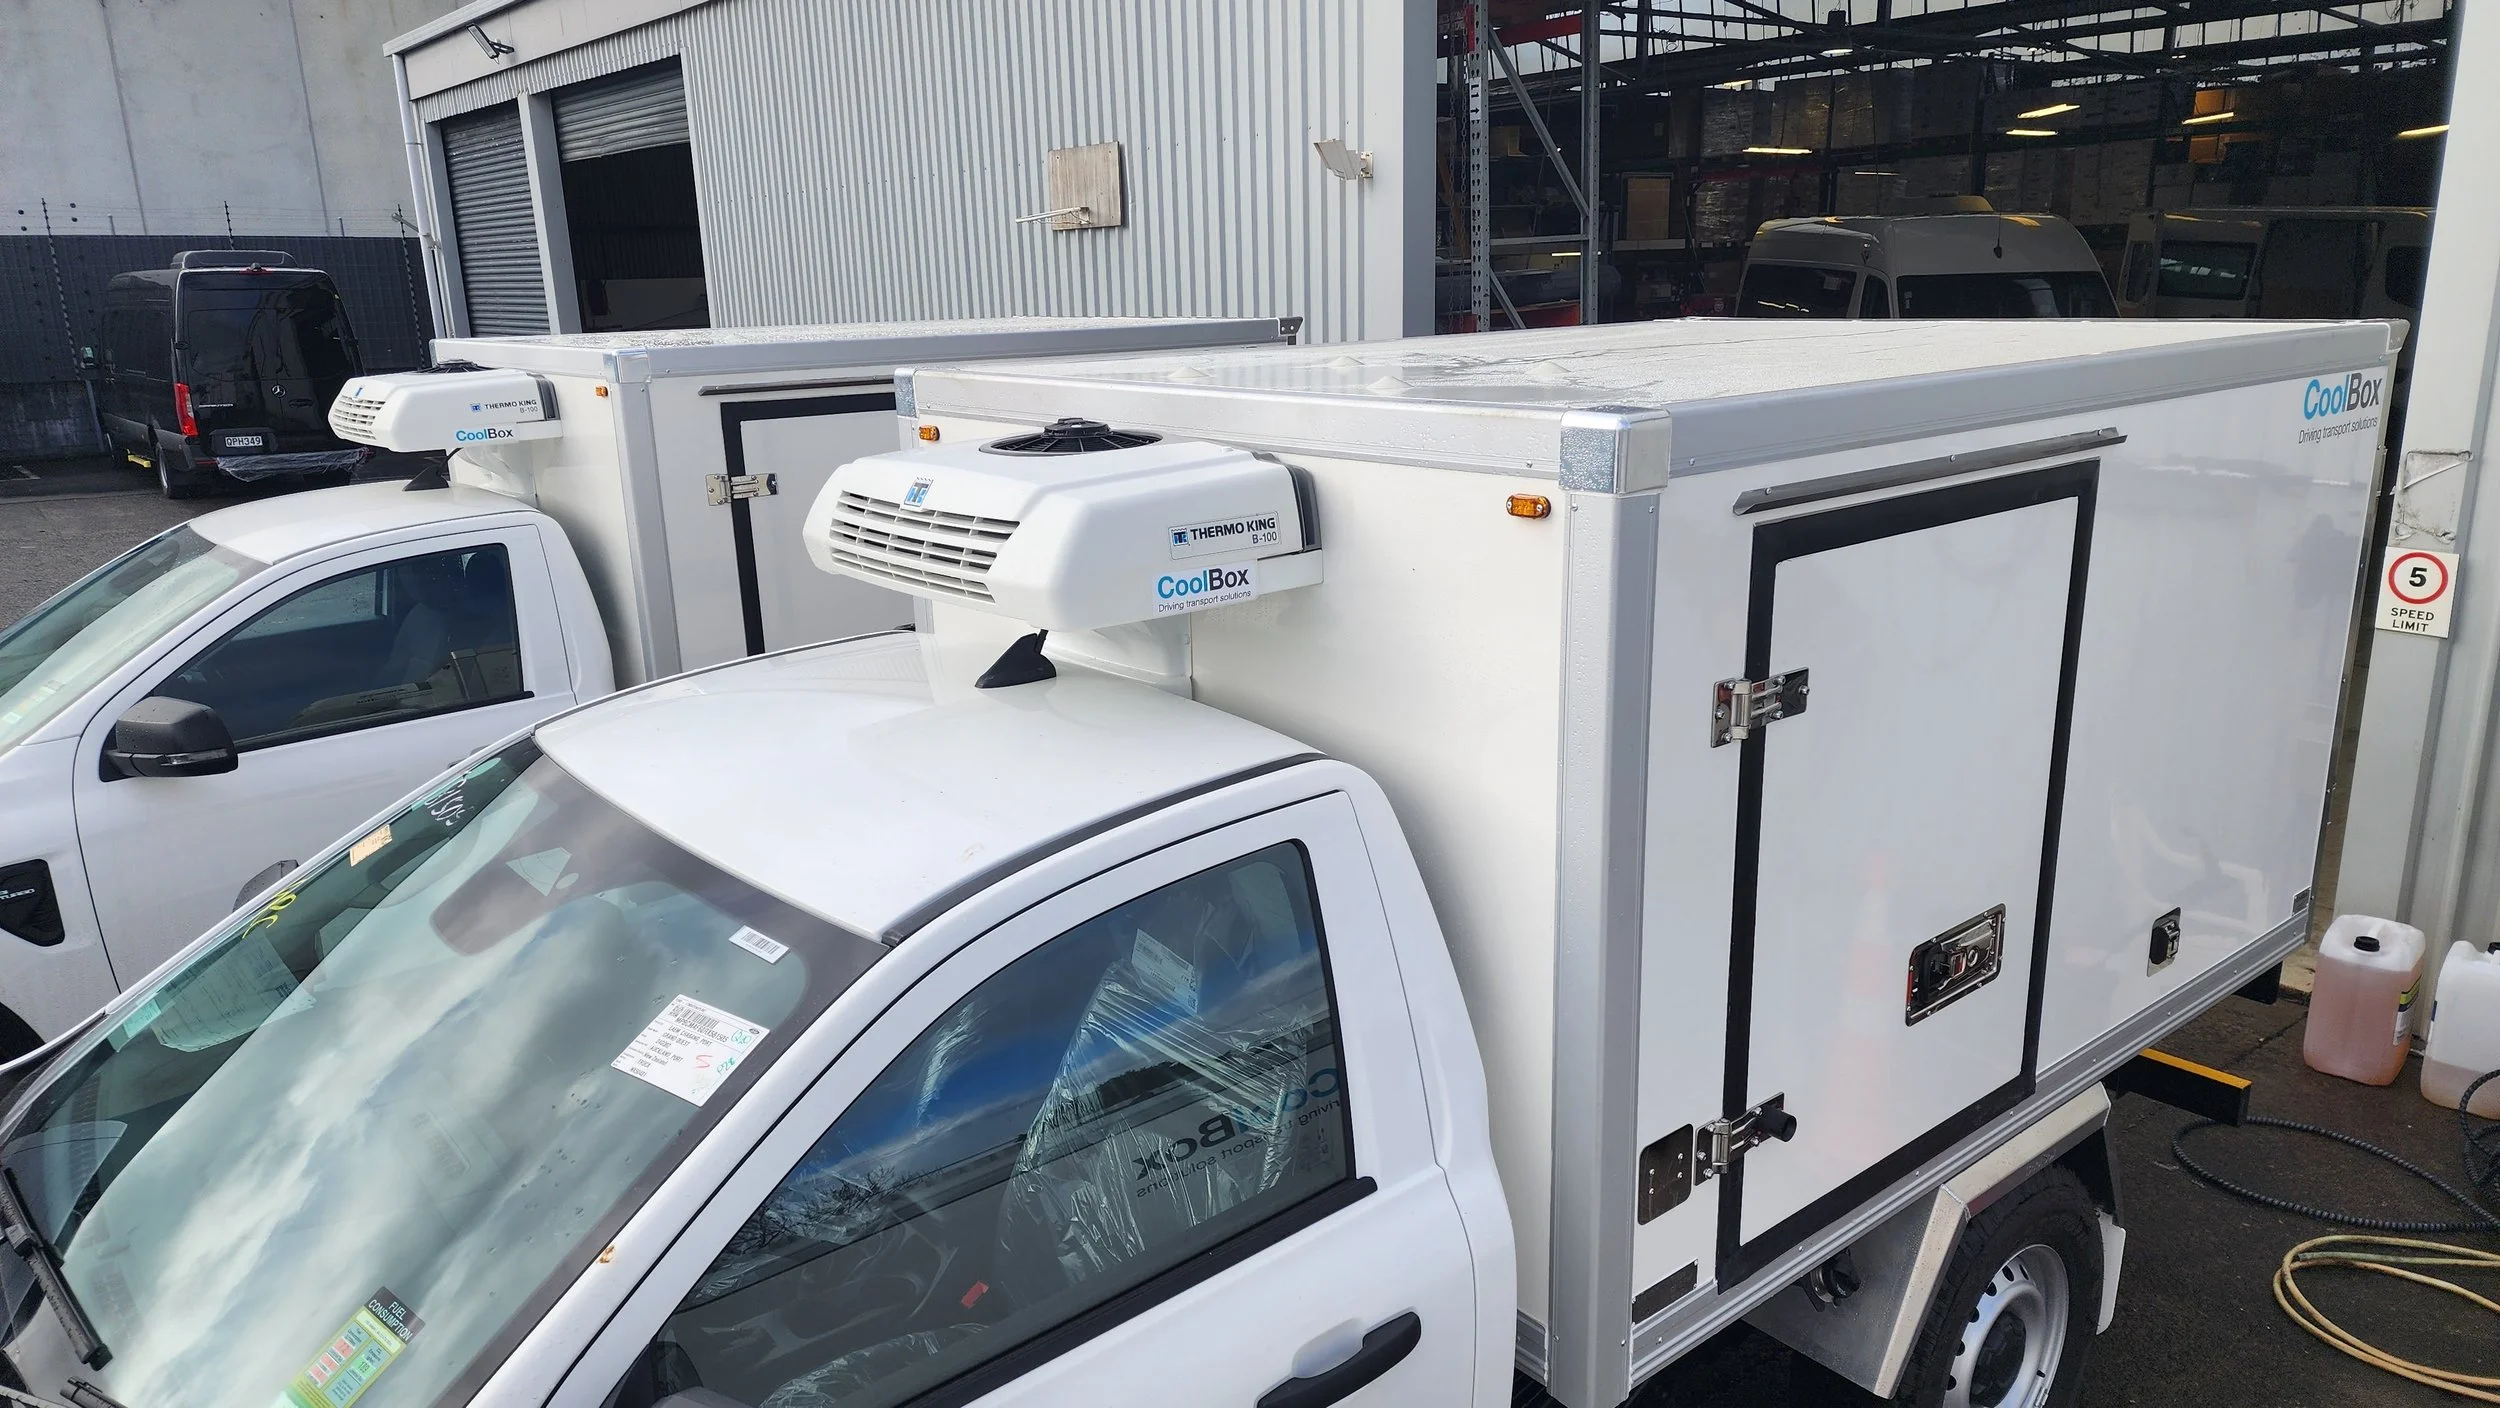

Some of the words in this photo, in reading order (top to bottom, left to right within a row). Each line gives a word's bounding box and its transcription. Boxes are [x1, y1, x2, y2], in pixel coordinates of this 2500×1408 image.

[484, 401, 517, 410] THERMO
[518, 399, 537, 407] KING
[2304, 372, 2382, 420] CoolBox
[456, 428, 513, 441] CoolBox
[2298, 428, 2322, 444] Driving
[2322, 422, 2351, 439] transport
[2351, 416, 2378, 432] solutions
[1190, 522, 1245, 540] THERMO
[1246, 517, 1276, 533] KING
[1252, 531, 1278, 544] B-100
[1157, 568, 1250, 599] CoolBox
[2408, 566, 2428, 587] 5
[1158, 600, 1185, 612] Driving
[1186, 595, 1218, 608] transport
[1219, 590, 1252, 602] solutions
[2391, 607, 2435, 621] SPEED
[2392, 619, 2429, 632] LIMIT
[368, 1299, 414, 1342] CONSUMPTION
[388, 1301, 407, 1321] FUEL
